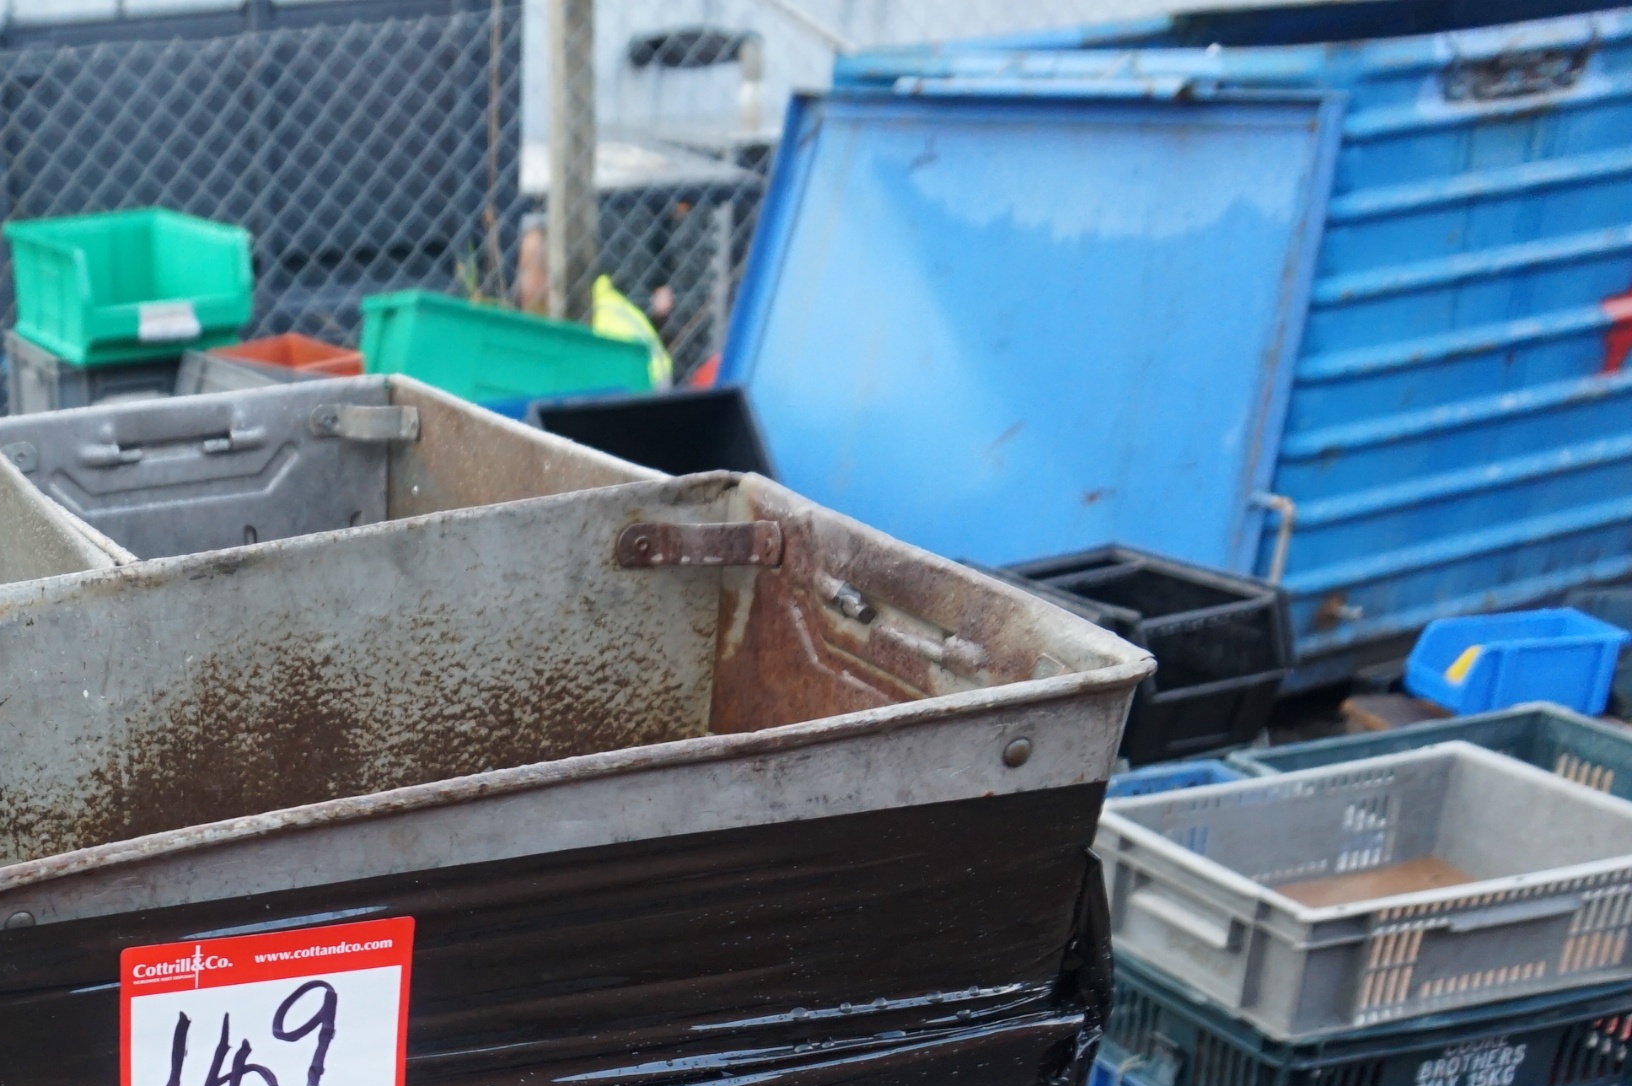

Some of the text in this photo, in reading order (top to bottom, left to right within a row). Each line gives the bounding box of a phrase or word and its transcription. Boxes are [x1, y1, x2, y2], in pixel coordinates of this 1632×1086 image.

[254, 939, 393, 963] www.cottandco.com
[132, 955, 234, 978] Cottrill&Co.
[1415, 1043, 1527, 1081] BROTHERS
